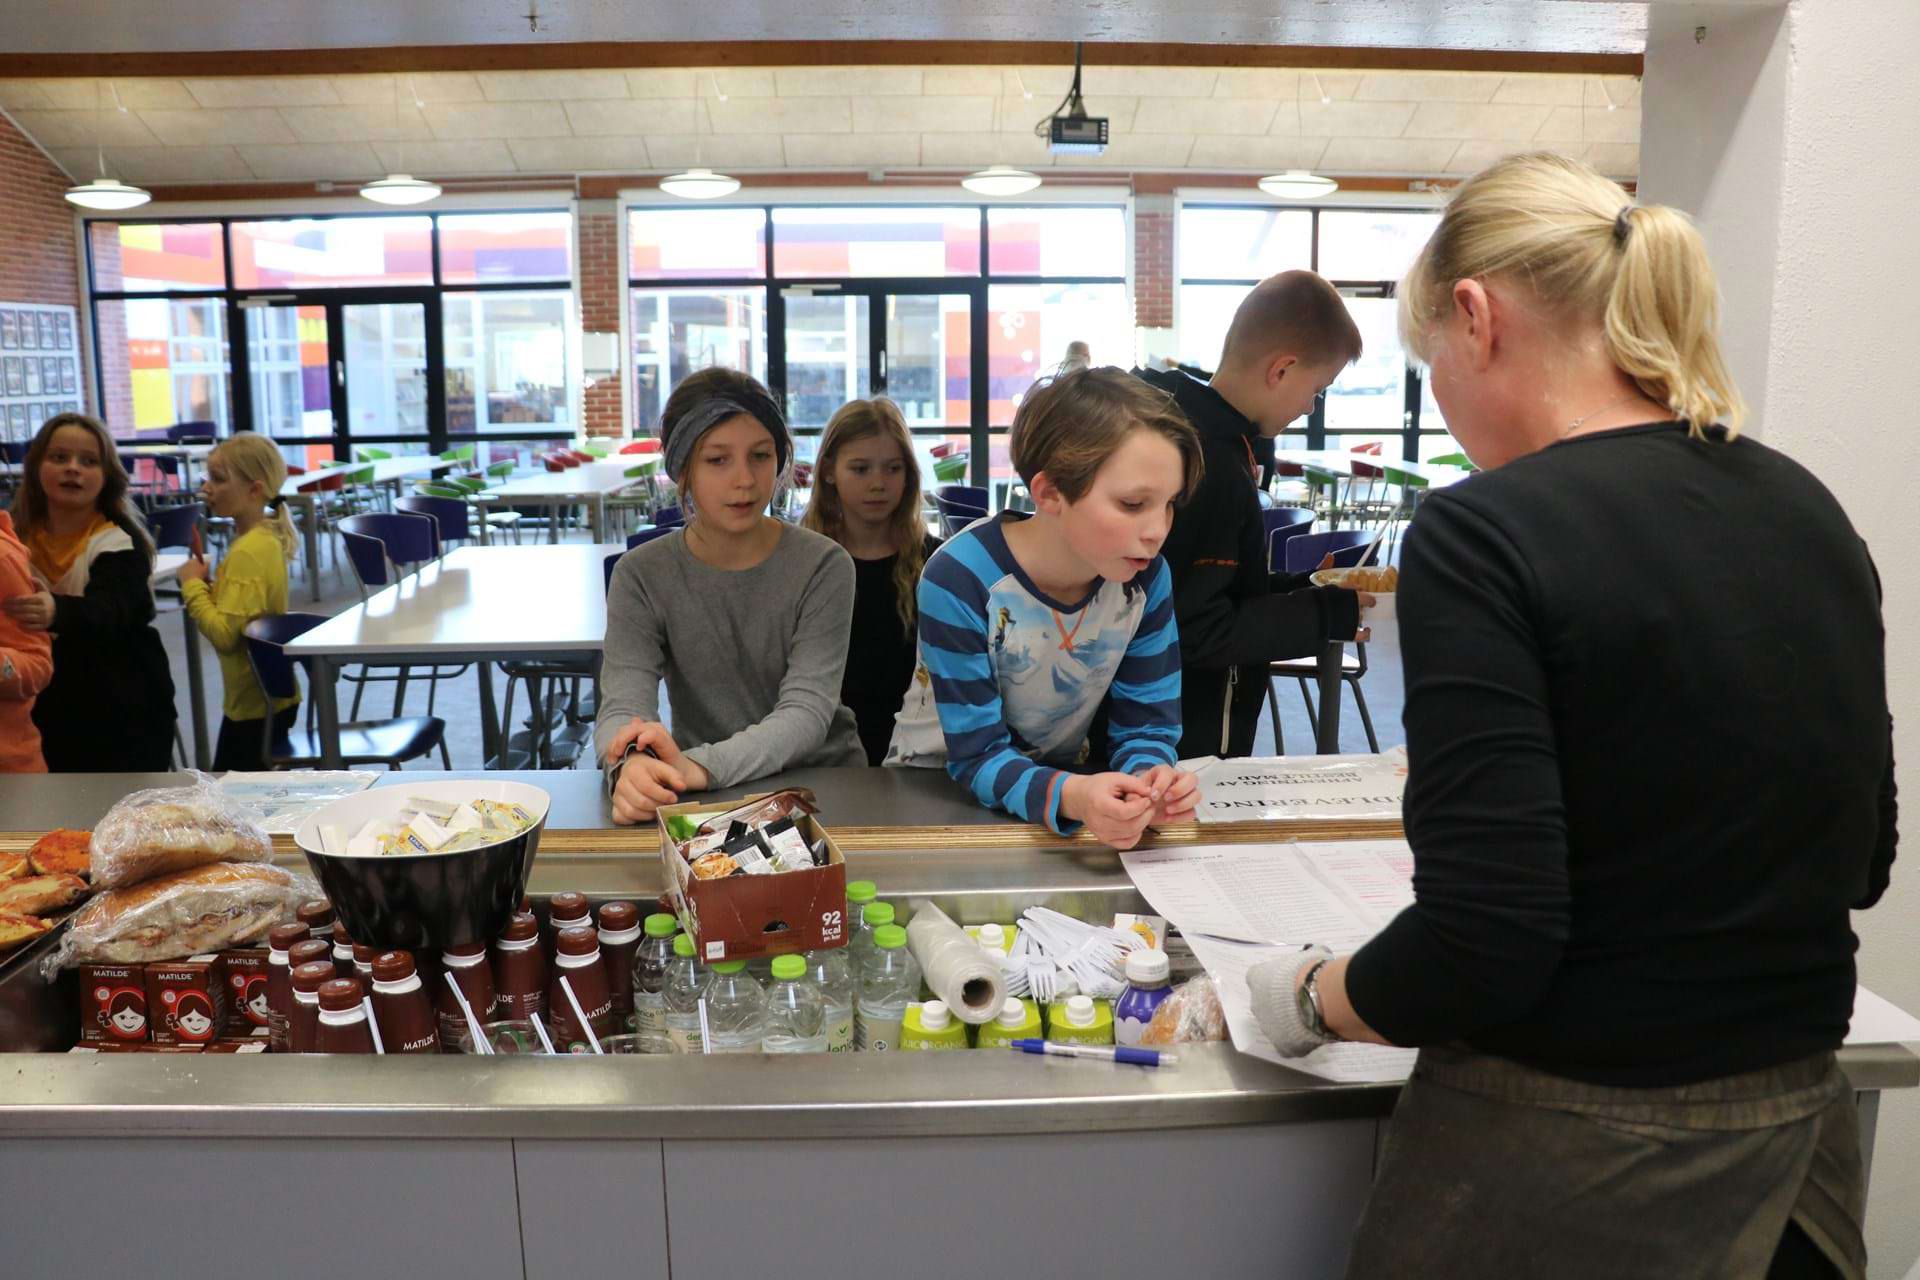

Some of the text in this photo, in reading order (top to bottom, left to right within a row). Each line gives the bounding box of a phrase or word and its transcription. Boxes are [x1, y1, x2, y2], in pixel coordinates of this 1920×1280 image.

[822, 910, 841, 926] 92
[822, 924, 841, 936] kcal
[403, 1033, 434, 1051] MATILDE
